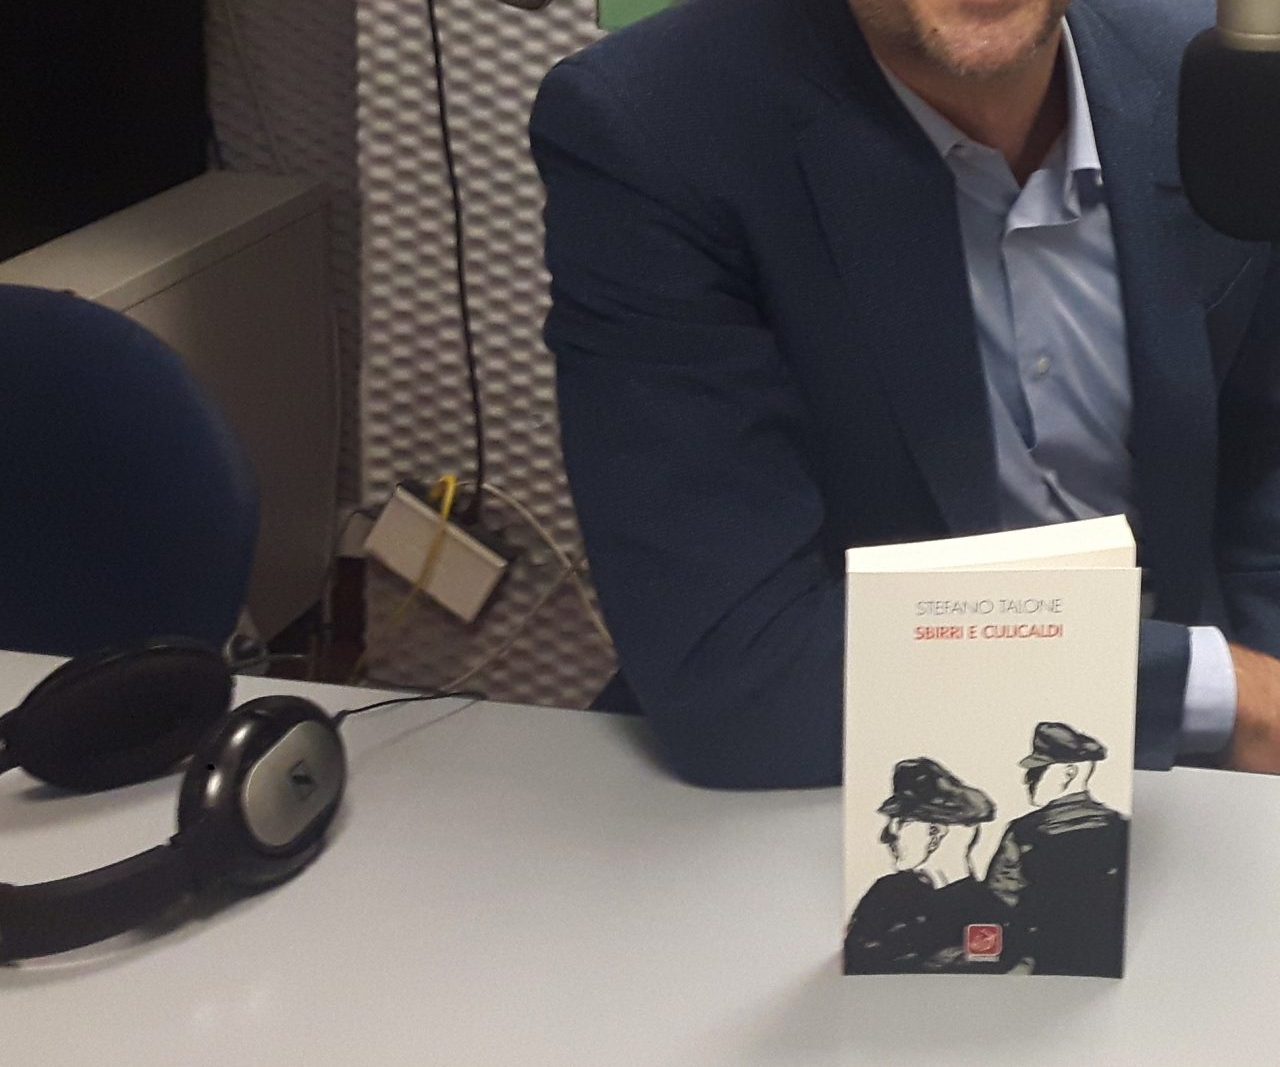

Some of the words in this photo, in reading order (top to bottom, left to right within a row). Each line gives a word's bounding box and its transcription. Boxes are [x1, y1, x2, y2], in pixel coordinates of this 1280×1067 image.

[916, 599, 995, 616] STEFANO
[999, 598, 1063, 614] TALONE
[914, 625, 964, 640] SBIRRI
[968, 624, 979, 639] E
[981, 623, 1064, 639] CULICALDI
